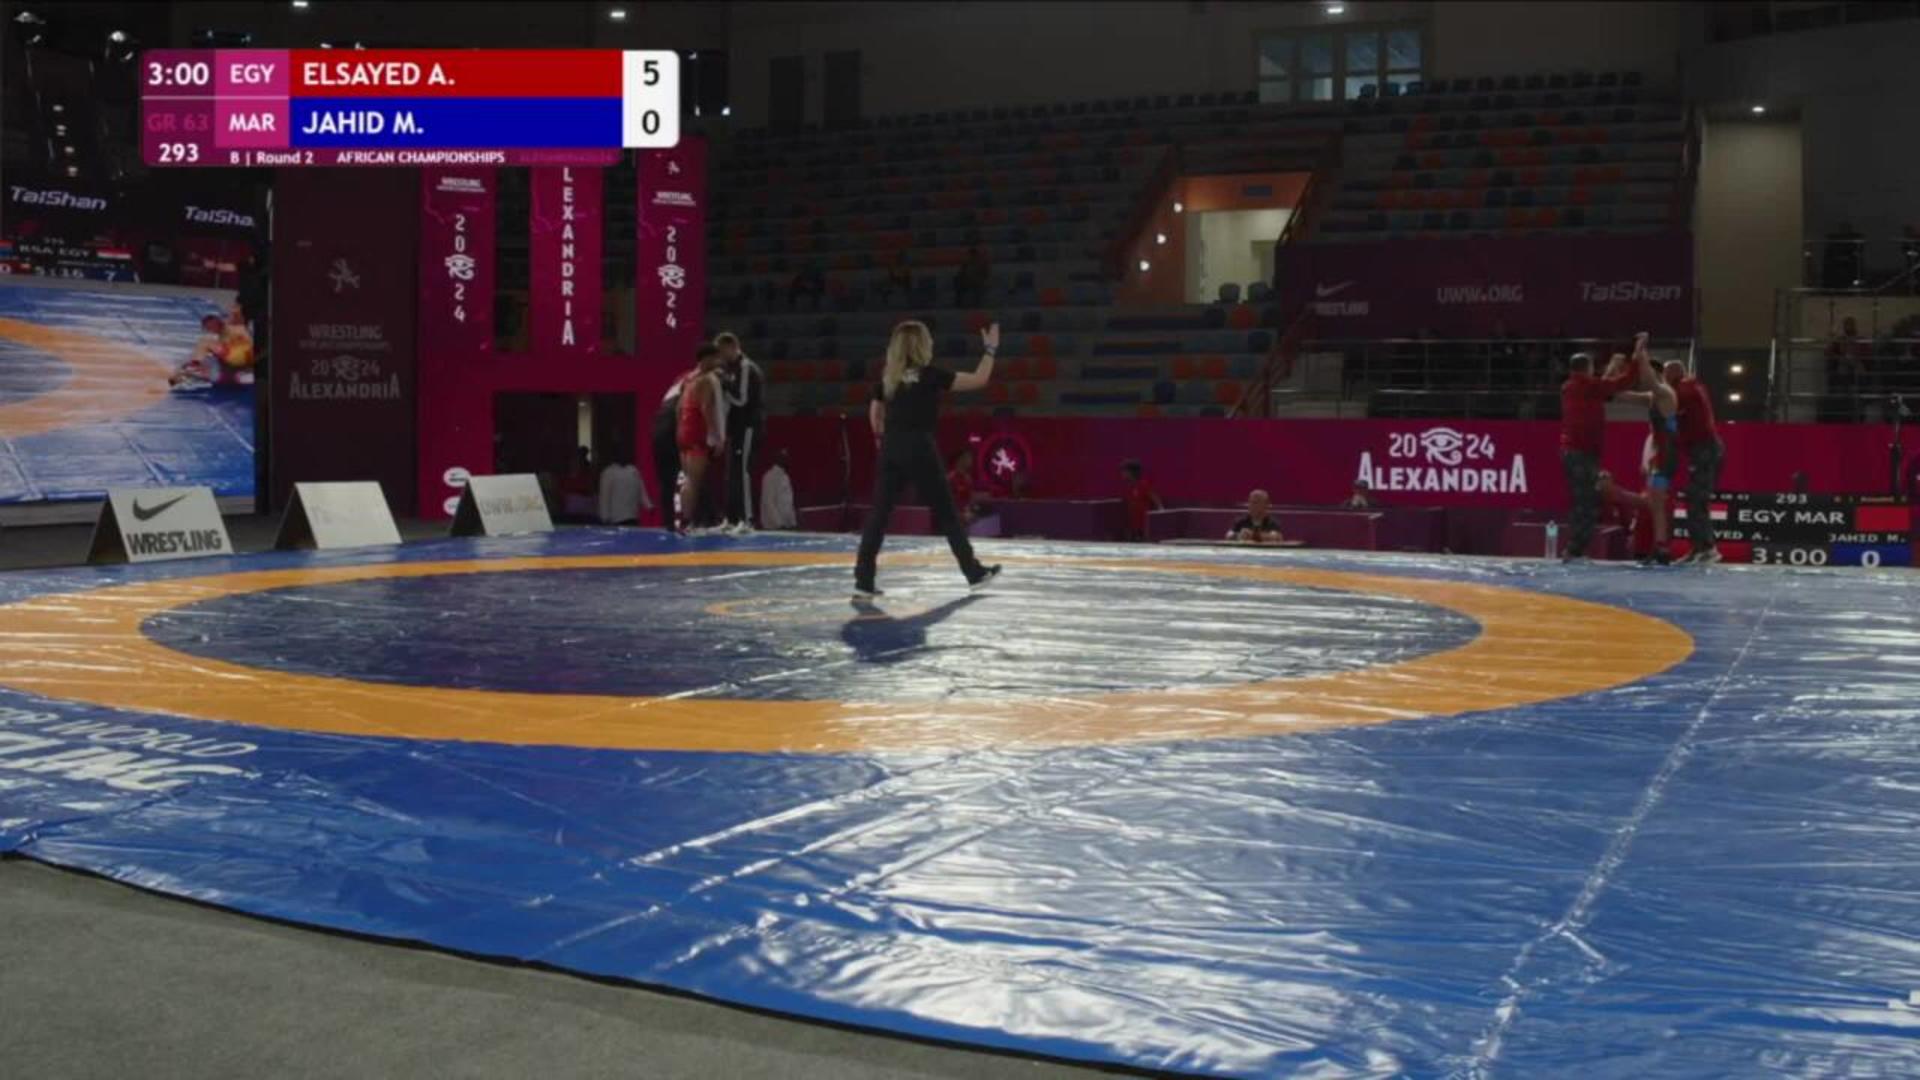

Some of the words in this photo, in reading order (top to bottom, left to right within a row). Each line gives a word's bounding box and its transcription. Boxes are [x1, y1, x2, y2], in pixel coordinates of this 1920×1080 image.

[11, 186, 107, 211] TaiShan
[184, 205, 255, 227] TaiSha
[562, 167, 574, 346] LEXANDRIA
[1437, 285, 1523, 305] UWW.ORG
[1579, 281, 1681, 302] TaiShan
[311, 359, 330, 376] 20
[360, 359, 381, 377] 24
[288, 371, 401, 400] ALEXANDRIA
[1389, 433, 1417, 457] 20
[1466, 434, 1495, 459] 24
[1357, 451, 1528, 493] ALEXANDRIA
[1776, 493, 1808, 504] 293
[1738, 509, 1785, 523] EGY
[1794, 510, 1845, 525] MAR
[126, 529, 222, 555] WRESTLING
[1828, 533, 1878, 543] JAHID
[1752, 548, 1827, 566] 3:00
[1861, 550, 1881, 568] 0
